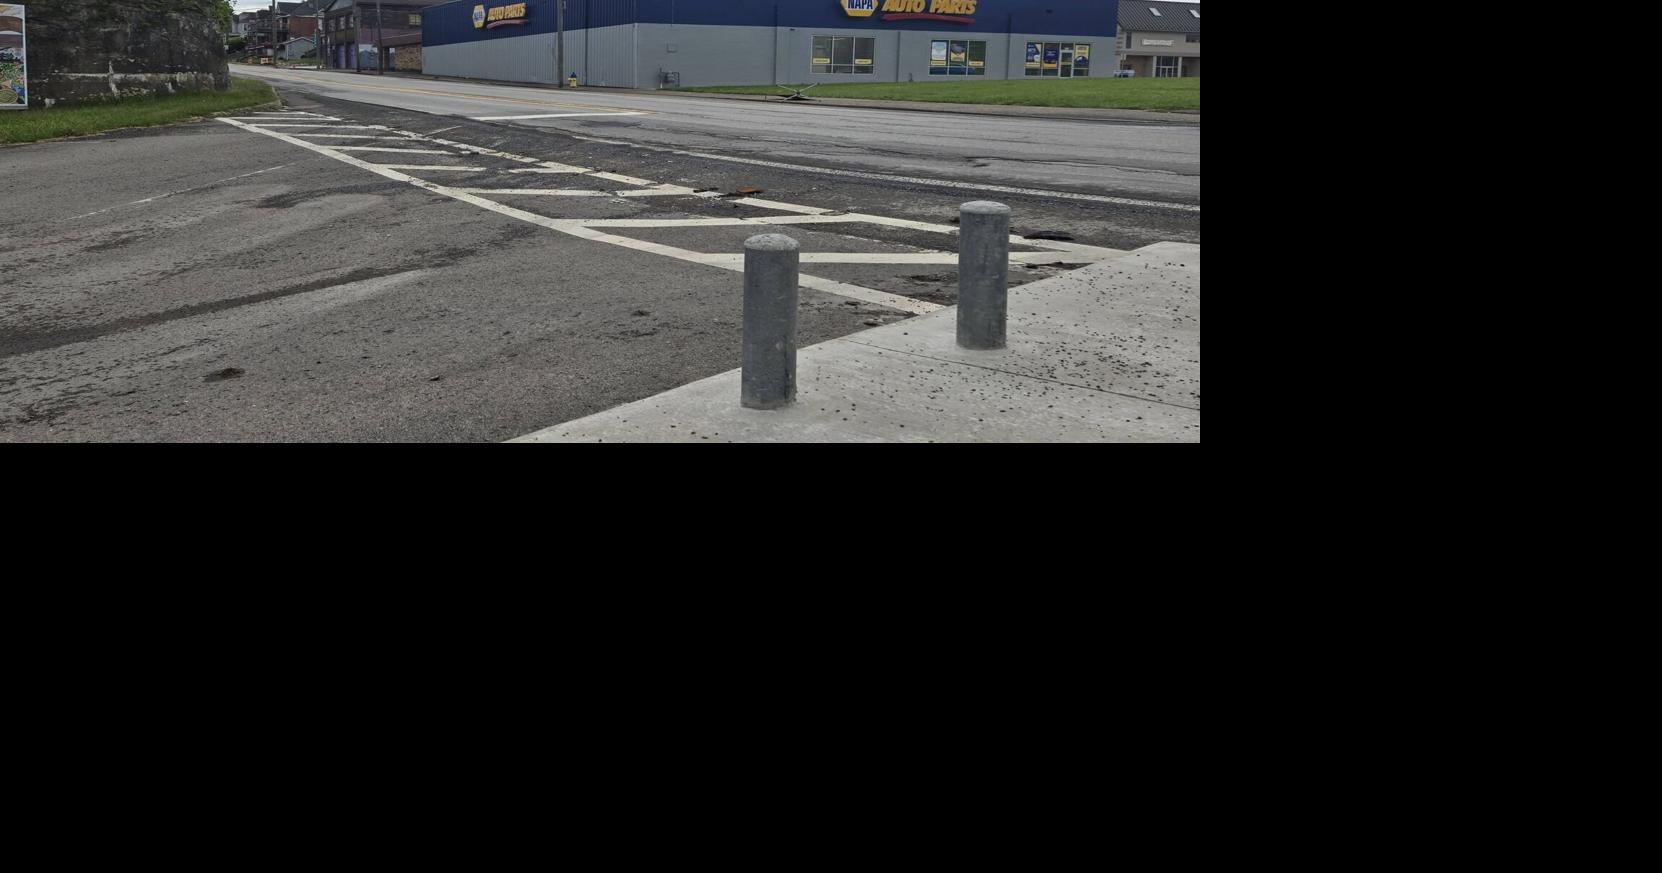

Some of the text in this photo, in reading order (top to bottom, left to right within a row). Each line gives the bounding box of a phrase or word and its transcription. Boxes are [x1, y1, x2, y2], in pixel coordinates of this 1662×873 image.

[847, 0, 873, 9] NAPA
[881, 0, 976, 14] AUTO PARTS
